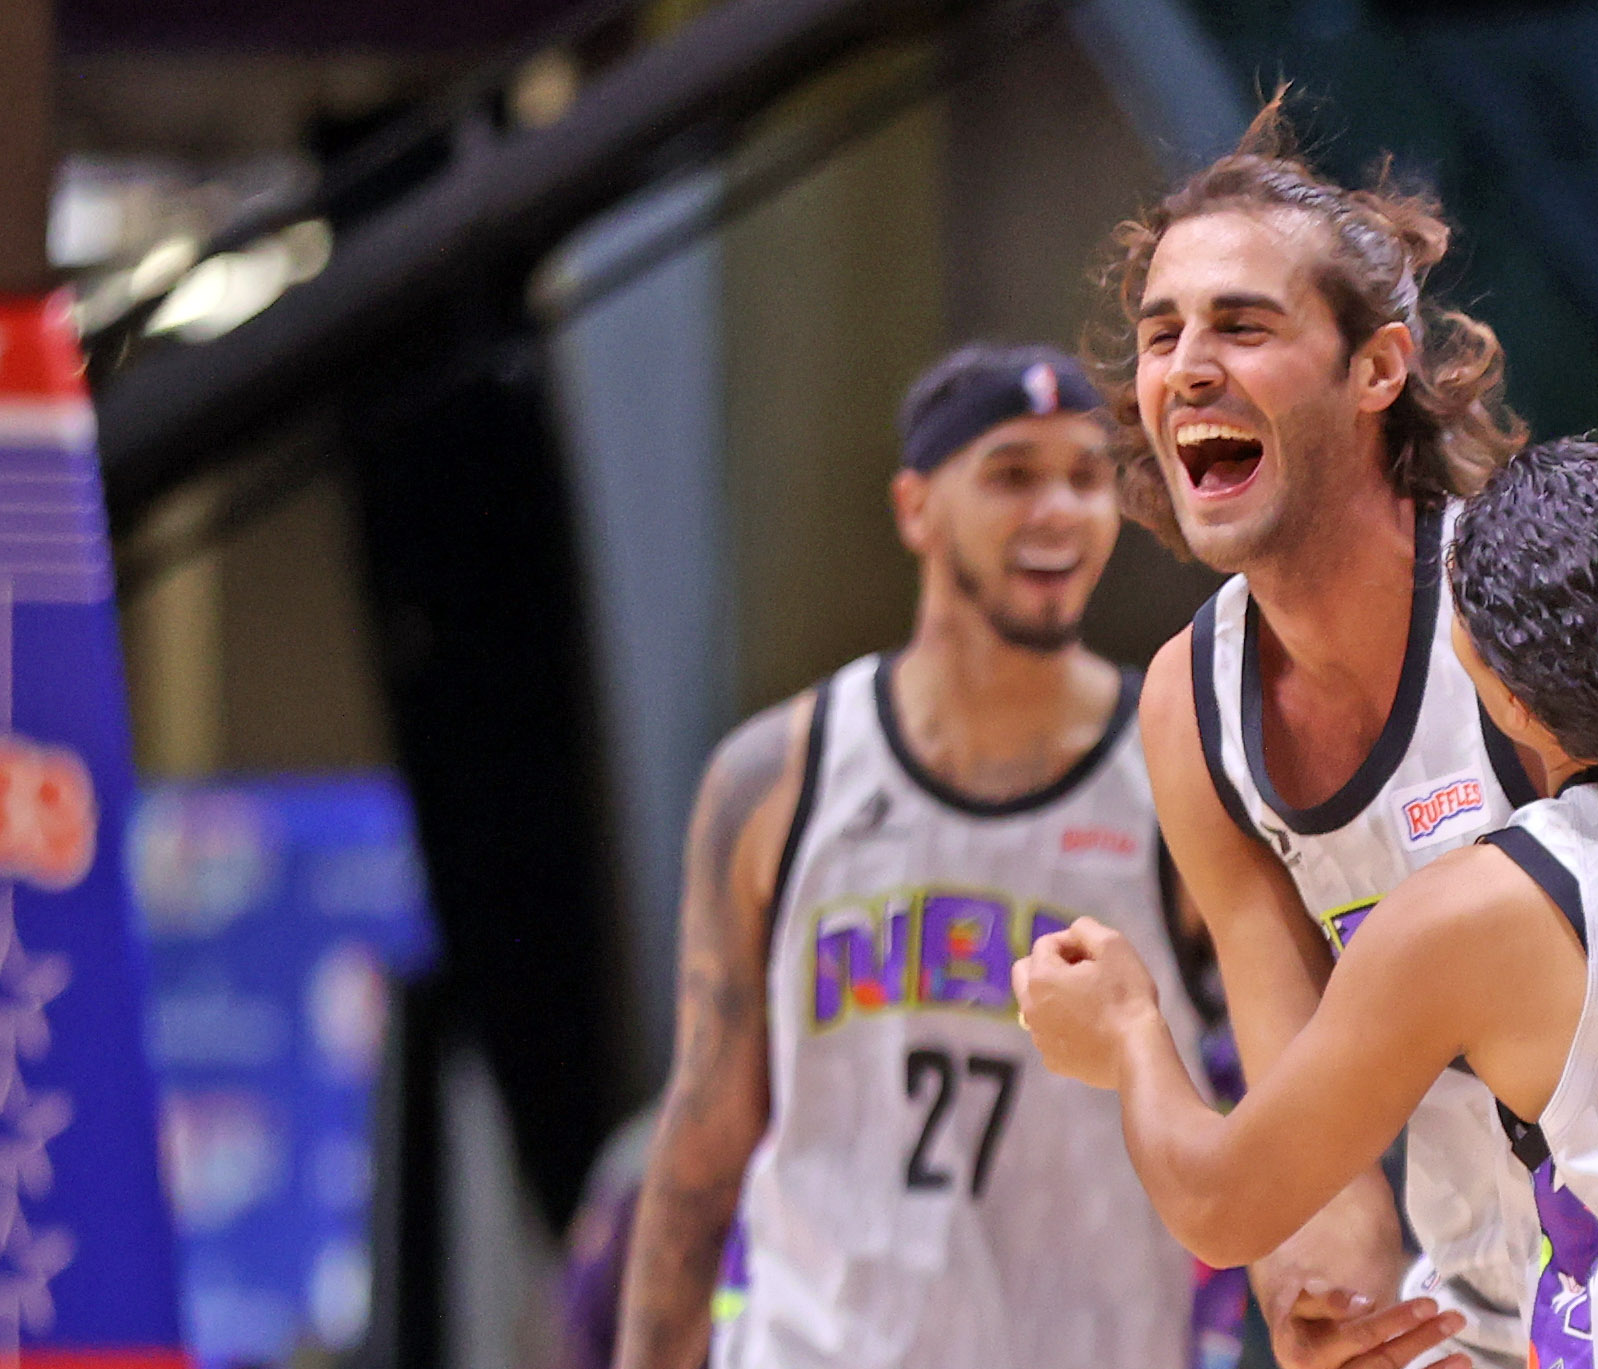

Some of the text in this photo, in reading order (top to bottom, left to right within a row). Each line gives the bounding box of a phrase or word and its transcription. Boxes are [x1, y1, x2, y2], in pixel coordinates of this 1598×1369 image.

[1405, 781, 1483, 834] RUFFLES
[810, 885, 1073, 1033] NB
[905, 1047, 1022, 1198] 27
